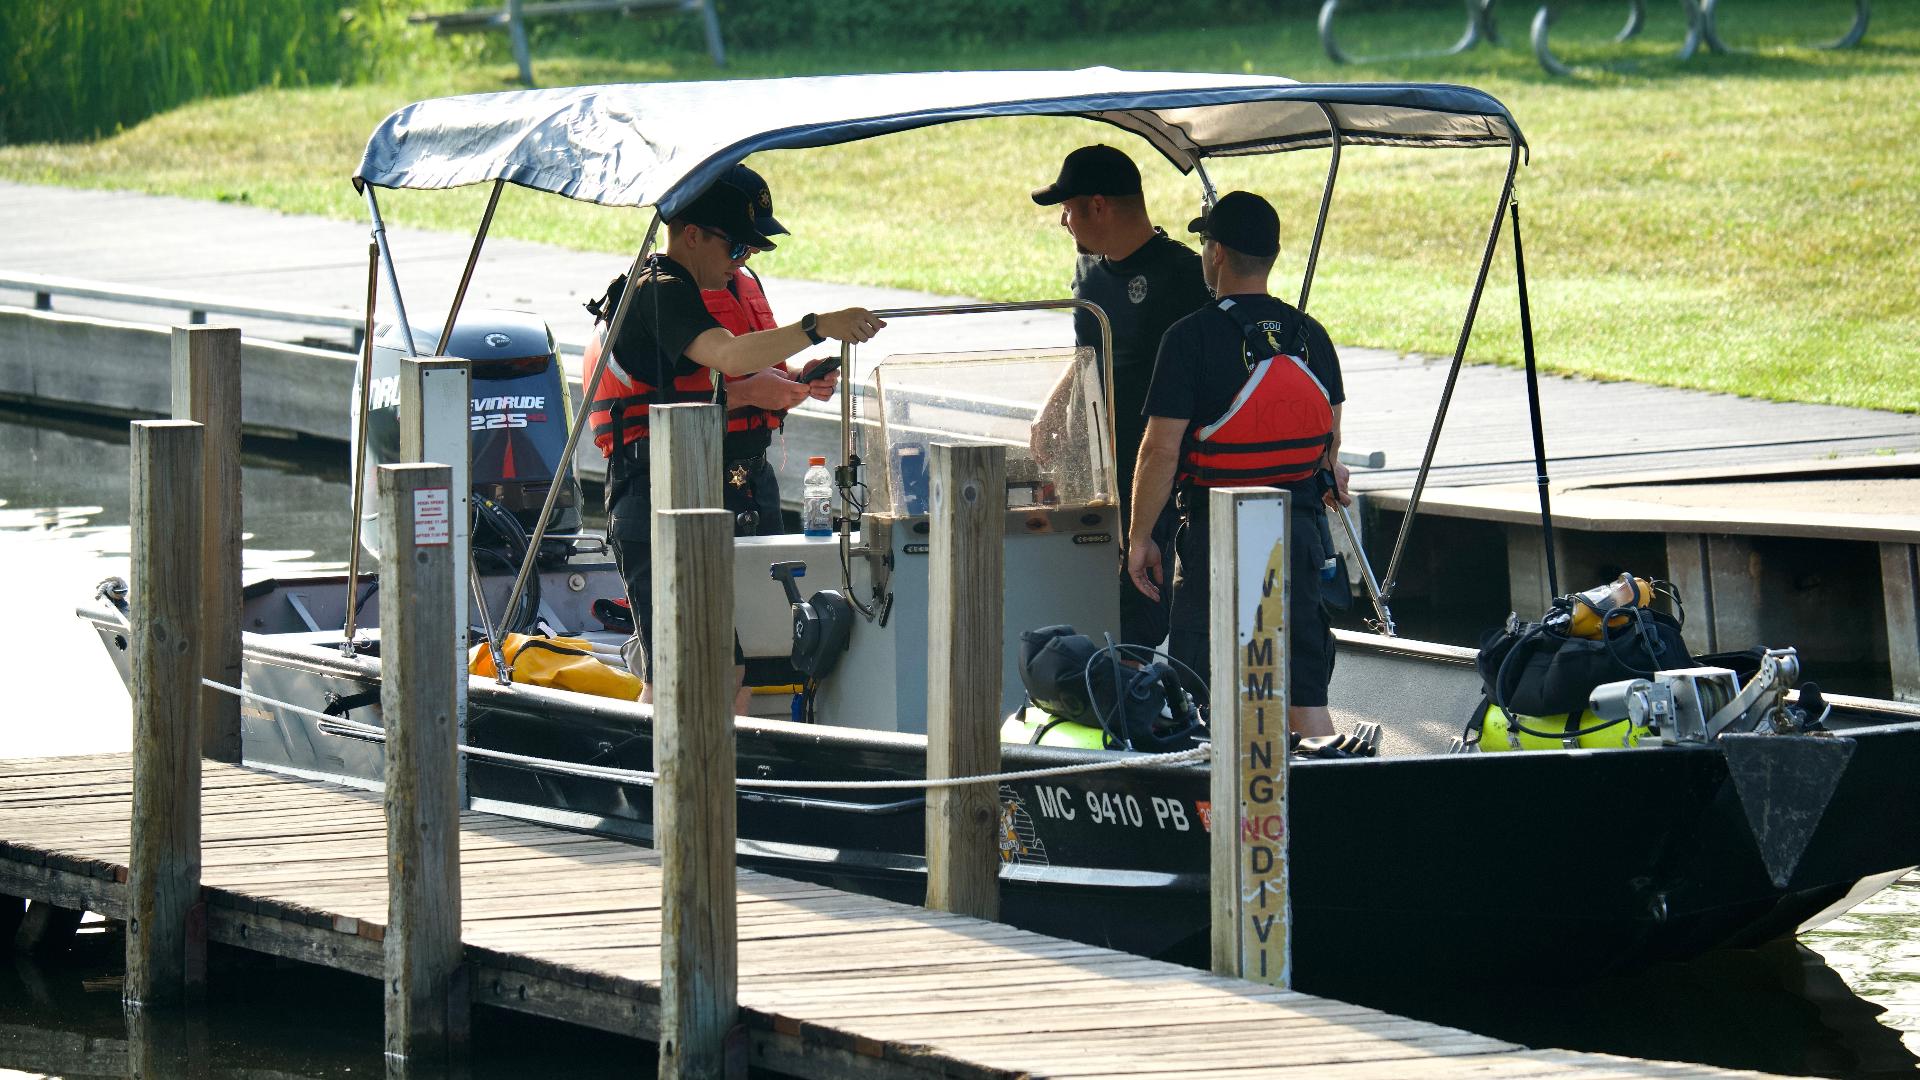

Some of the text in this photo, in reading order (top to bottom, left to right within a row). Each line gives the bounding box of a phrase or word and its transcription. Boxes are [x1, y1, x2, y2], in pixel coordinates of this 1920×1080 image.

[471, 413, 528, 431] 225
[1035, 785, 1190, 832] MC 9410 PB
[1242, 815, 1284, 842] NO
[1251, 846, 1275, 978] DIVI
